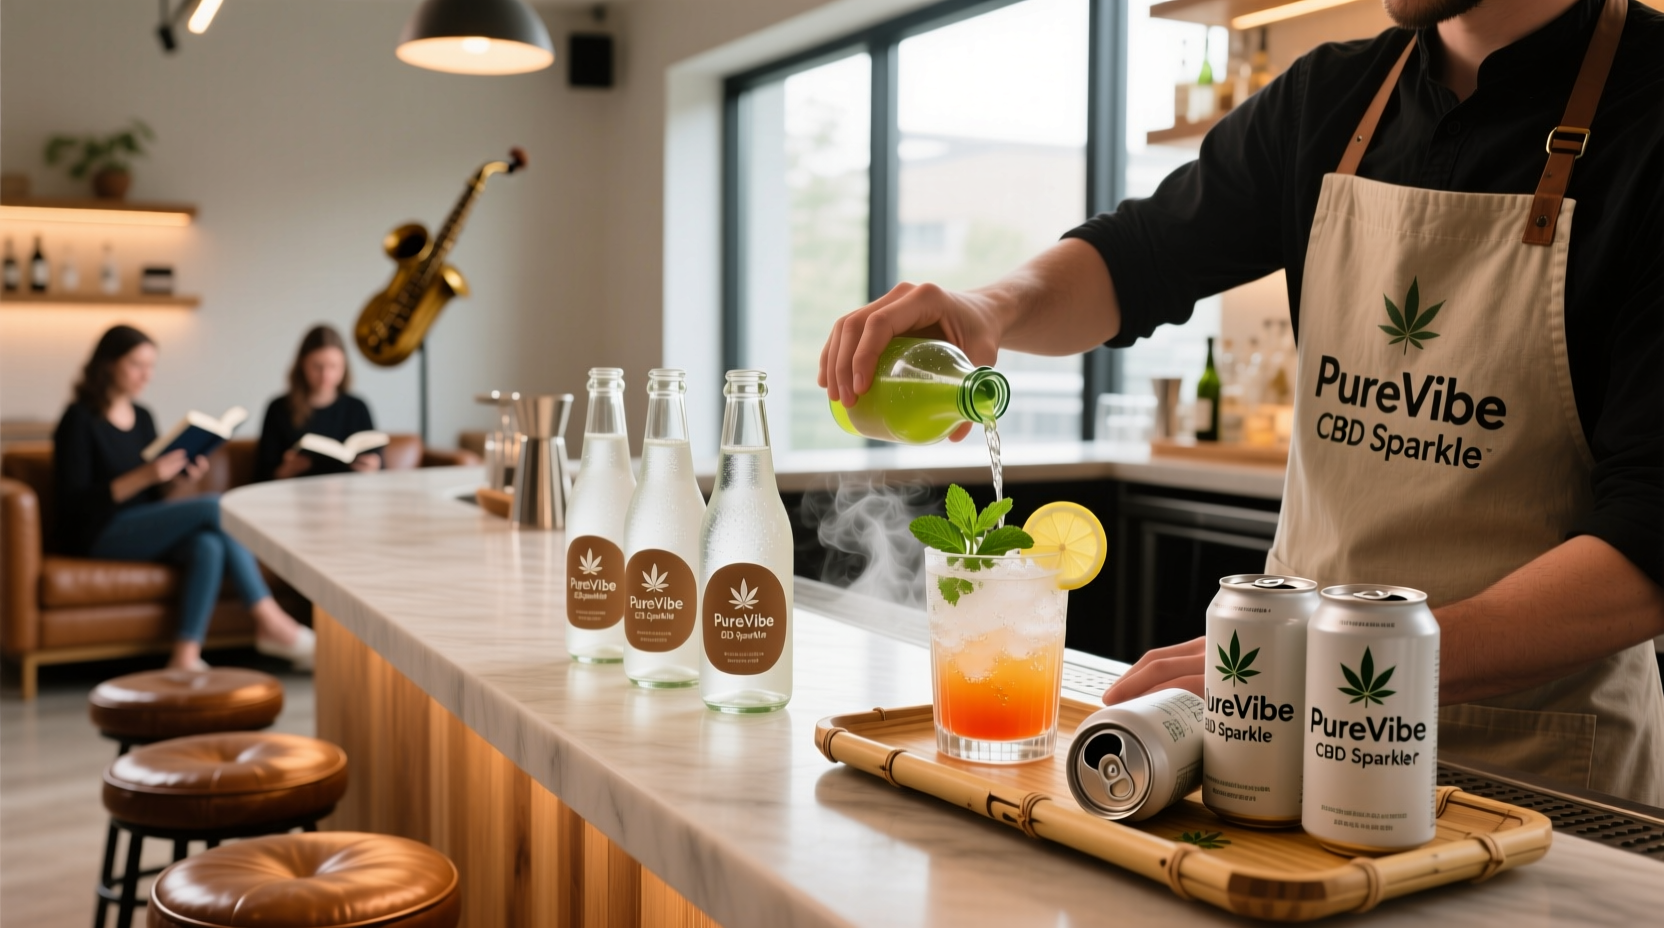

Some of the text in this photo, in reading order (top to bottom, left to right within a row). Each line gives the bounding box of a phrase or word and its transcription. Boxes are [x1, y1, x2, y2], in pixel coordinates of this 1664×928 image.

[1315, 355, 1506, 430] PureVibe
[1317, 412, 1482, 469] CBD Sparkle
[630, 595, 683, 610] PureVibe
[714, 613, 774, 628] PureVibe
[1218, 722, 1272, 743] Sparkle
[1310, 706, 1426, 742] PureVibe
[1315, 742, 1346, 761] CBD
